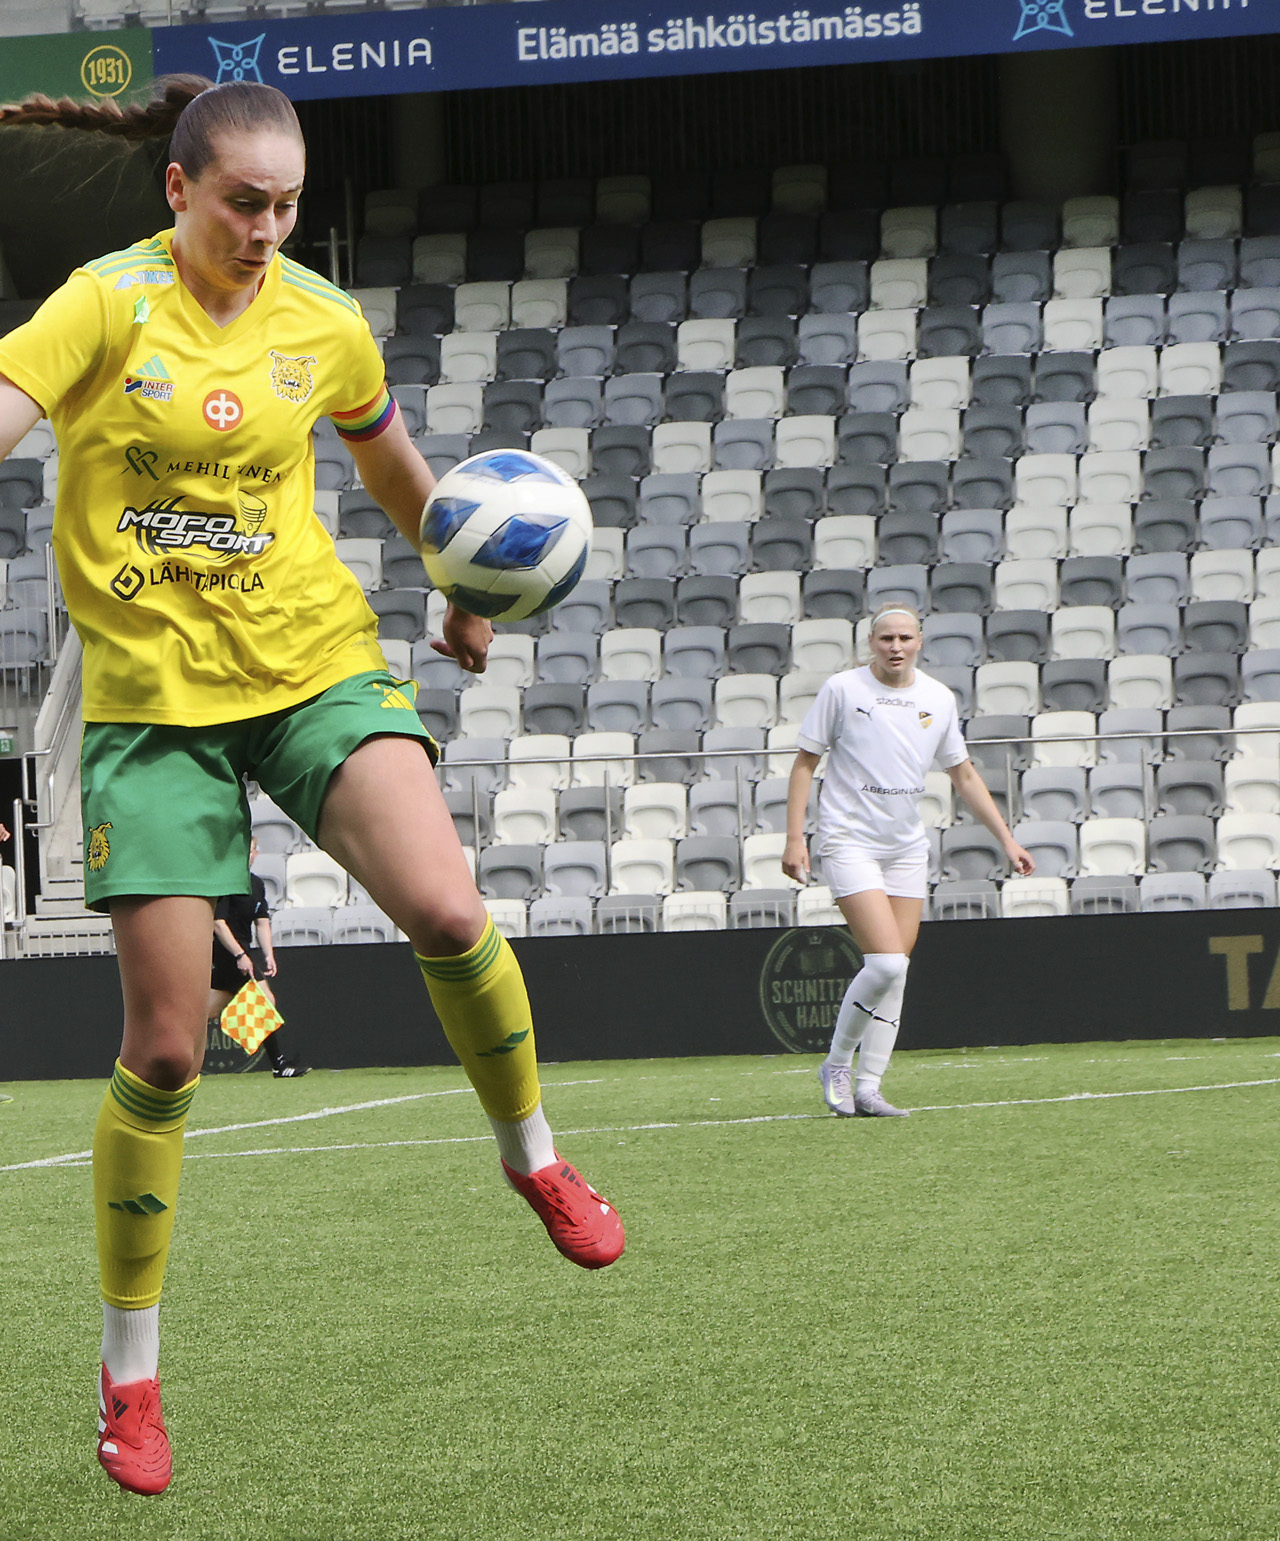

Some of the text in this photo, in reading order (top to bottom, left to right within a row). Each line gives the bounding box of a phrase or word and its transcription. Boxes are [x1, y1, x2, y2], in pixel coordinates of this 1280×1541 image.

[517, 3, 922, 61] Elämää sähköistämässä
[277, 38, 433, 75] ELENIA
[87, 57, 126, 85] 1931
[141, 388, 172, 401] SPORT
[143, 380, 174, 392] INTER
[117, 510, 235, 533] MOPO
[155, 530, 274, 552] SPORT
[876, 697, 916, 708] stadium
[771, 978, 850, 1004] SCHNITZ
